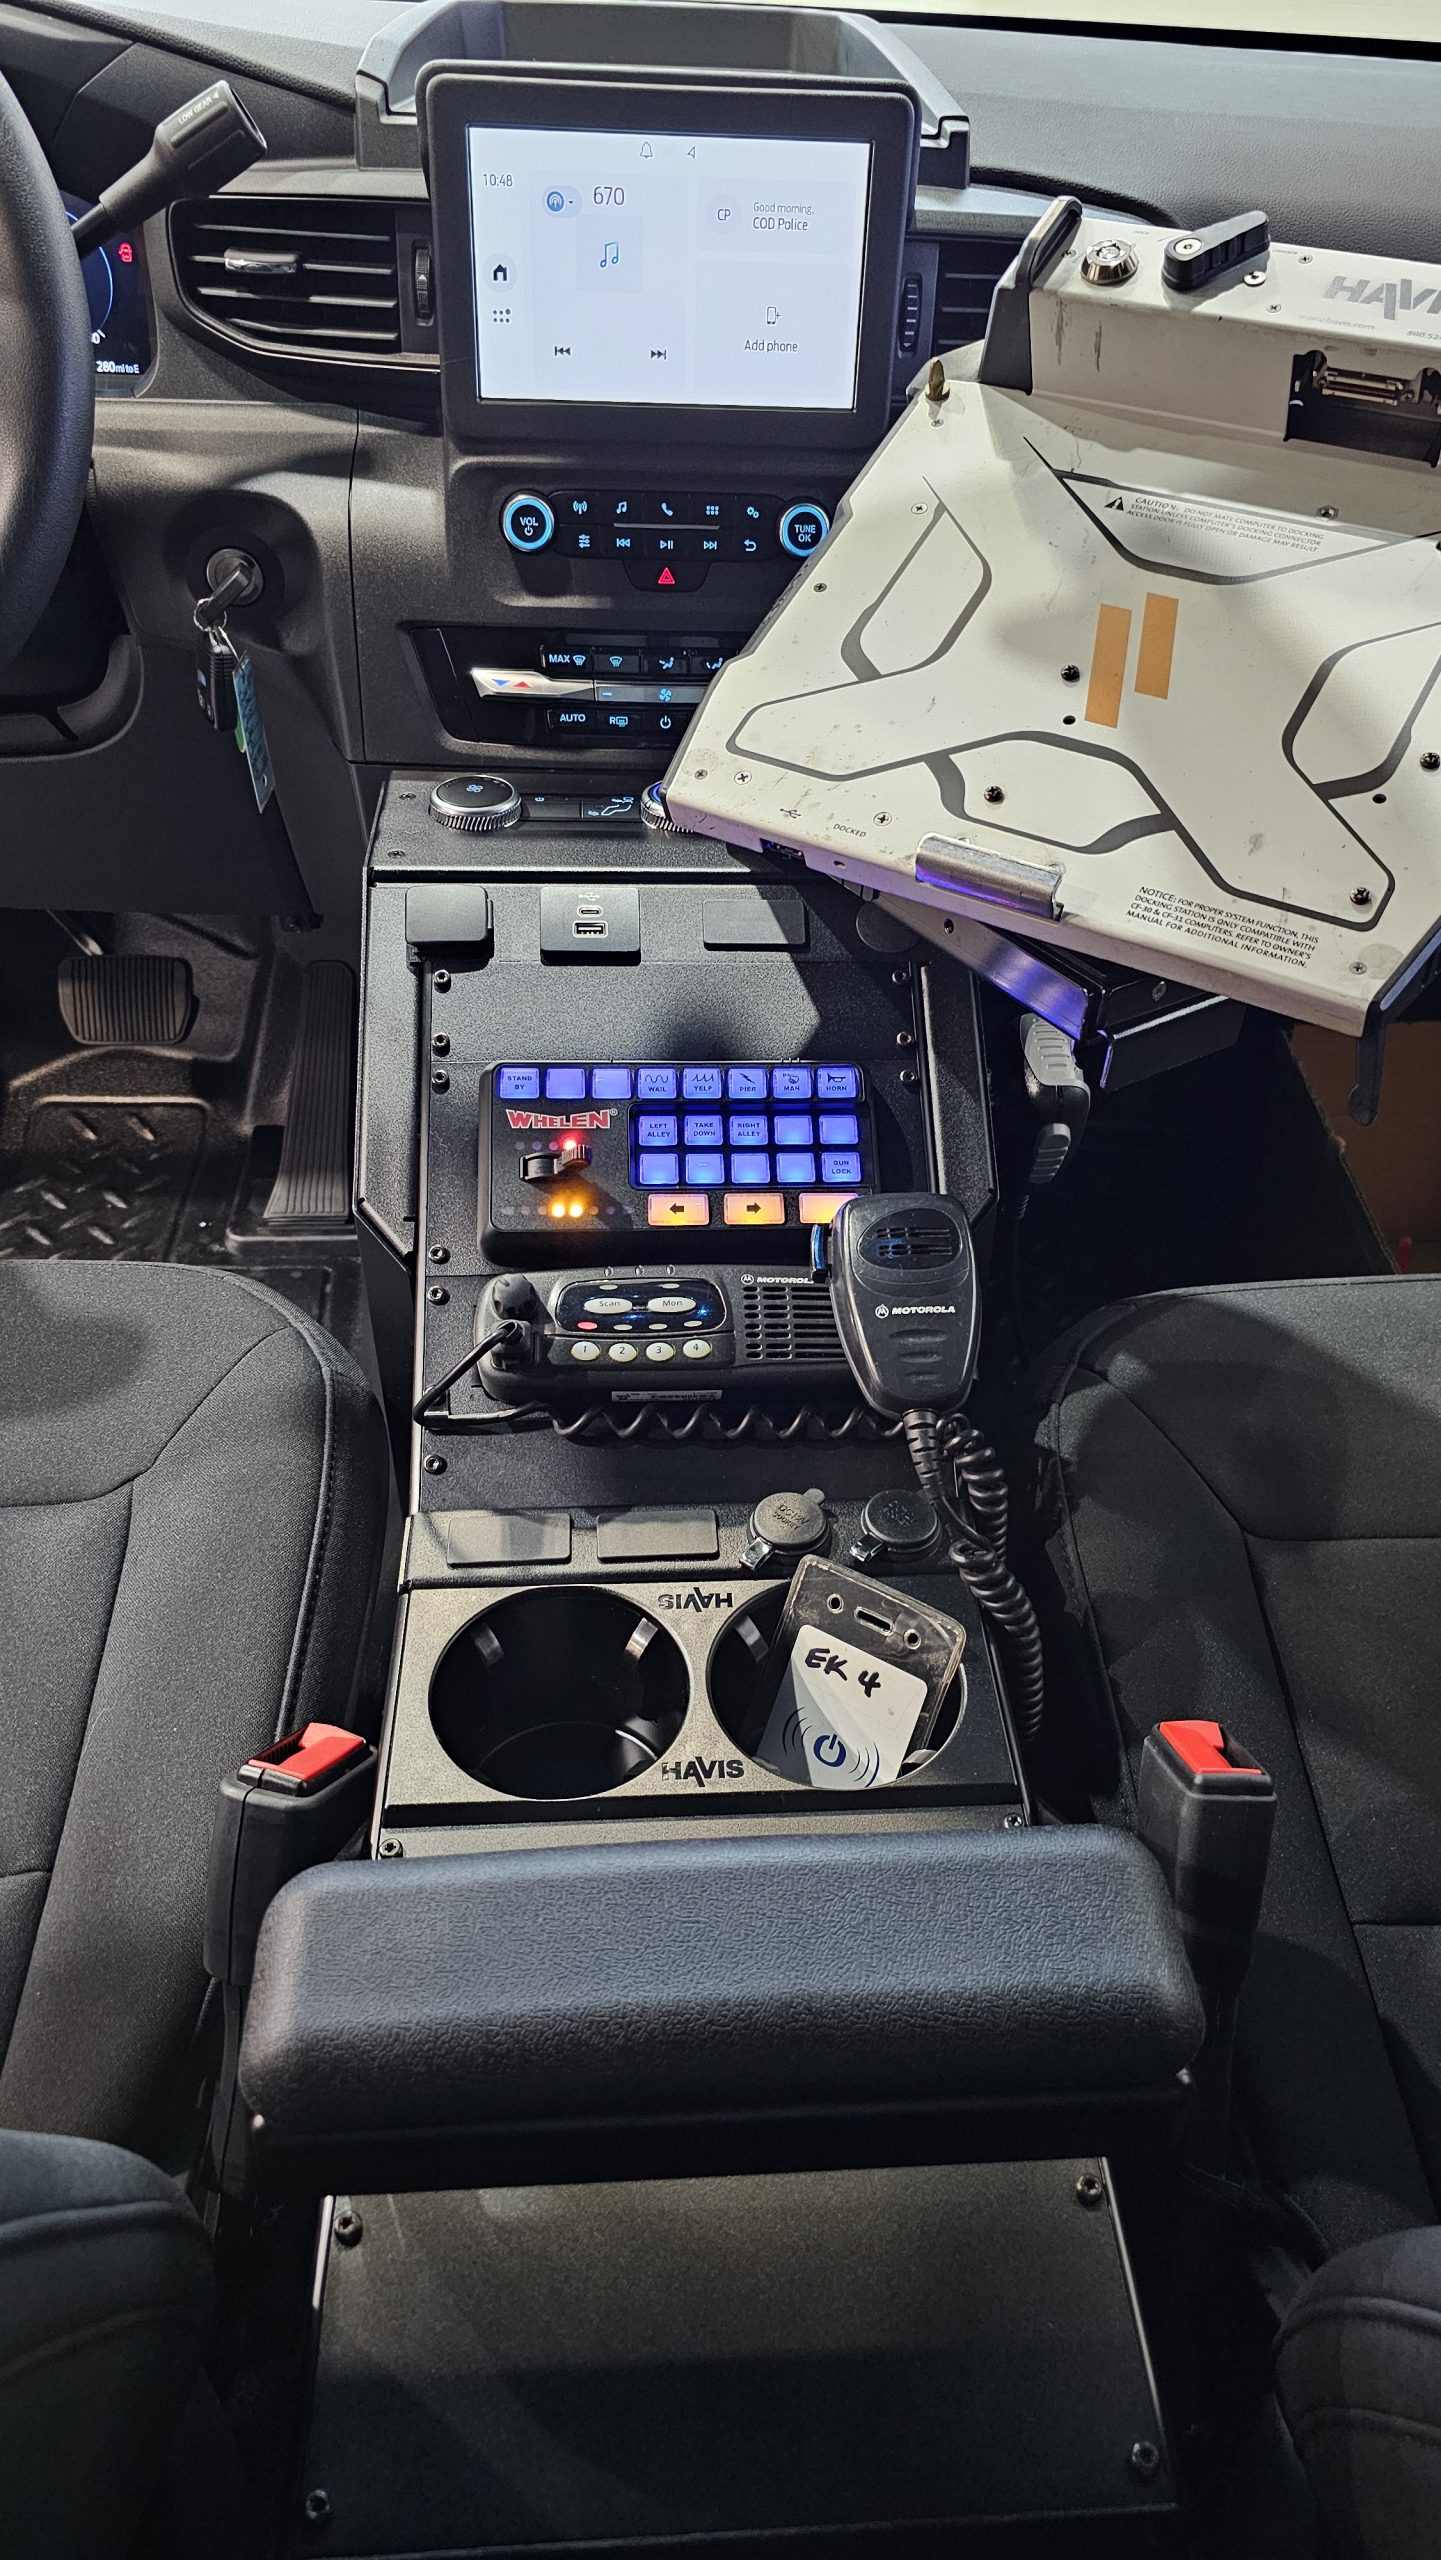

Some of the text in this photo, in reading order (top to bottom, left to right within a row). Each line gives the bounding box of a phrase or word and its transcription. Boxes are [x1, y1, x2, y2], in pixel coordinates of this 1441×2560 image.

[178, 96, 214, 125] LOW GEAR
[483, 173, 513, 187] 10:48
[593, 186, 625, 206] 670
[753, 202, 776, 213] Good
[717, 208, 731, 221] CP
[752, 216, 808, 231] COD Police
[744, 339, 798, 353] Add phone
[95, 360, 116, 373] 280
[519, 516, 539, 527] VOL
[1131, 504, 1160, 515] STATION
[1161, 510, 1189, 520] UNLESS
[1236, 524, 1273, 537] DOCKING
[1273, 532, 1322, 546] CONNECTOR
[1196, 509, 1212, 517] NOT
[1234, 517, 1276, 531] COMPUTER
[1277, 525, 1287, 533] TO
[1288, 528, 1325, 540] DOCKING
[794, 524, 816, 534] TUNE
[1126, 510, 1152, 520] ACCESS
[1153, 515, 1174, 524] DOOR
[1183, 520, 1204, 531] FULLY
[1204, 525, 1226, 535] OPEN
[1226, 529, 1238, 537] OR
[1238, 532, 1272, 544] DAMAGE
[1272, 539, 1290, 548] MAY
[1290, 543, 1319, 553] RESULT
[798, 533, 812, 543] OK
[548, 654, 571, 664] MAX
[559, 713, 586, 723] AUTO
[833, 823, 867, 838] DOCKED
[1139, 886, 1177, 903] NOTICE:
[1177, 898, 1194, 908] FOR
[1194, 903, 1224, 917] PROPER
[1224, 911, 1255, 925] SYSTEM
[1301, 933, 1319, 944] THIS
[1134, 894, 1316, 952] DOCKING STATION IS ONLY COMPATIBLE WITH
[1130, 902, 1152, 914] CF-30
[1153, 907, 1161, 917] &
[1161, 911, 1183, 923] CF-31
[1235, 932, 1260, 945] REFER
[1260, 939, 1272, 949] TO
[1272, 943, 1312, 961] OWNER'S
[1126, 910, 1307, 969] MANUAL FOR ADDITIONAL INFORMATION.
[514, 1083, 525, 1091] BY
[737, 1130, 761, 1138] ALLEY
[831, 1168, 852, 1176] LOCK
[756, 1275, 814, 1284] MOTOROL
[662, 1299, 683, 1307] Mon
[891, 1305, 956, 1316] MOTOROLA
[582, 1345, 588, 1354] 1
[619, 1346, 626, 1355] 2
[656, 1346, 662, 1355] 3
[692, 1343, 699, 1352] 4
[657, 1587, 733, 1612] HAVIS
[805, 1648, 881, 1698] EK 4
[661, 1756, 745, 1787] HAVIS
